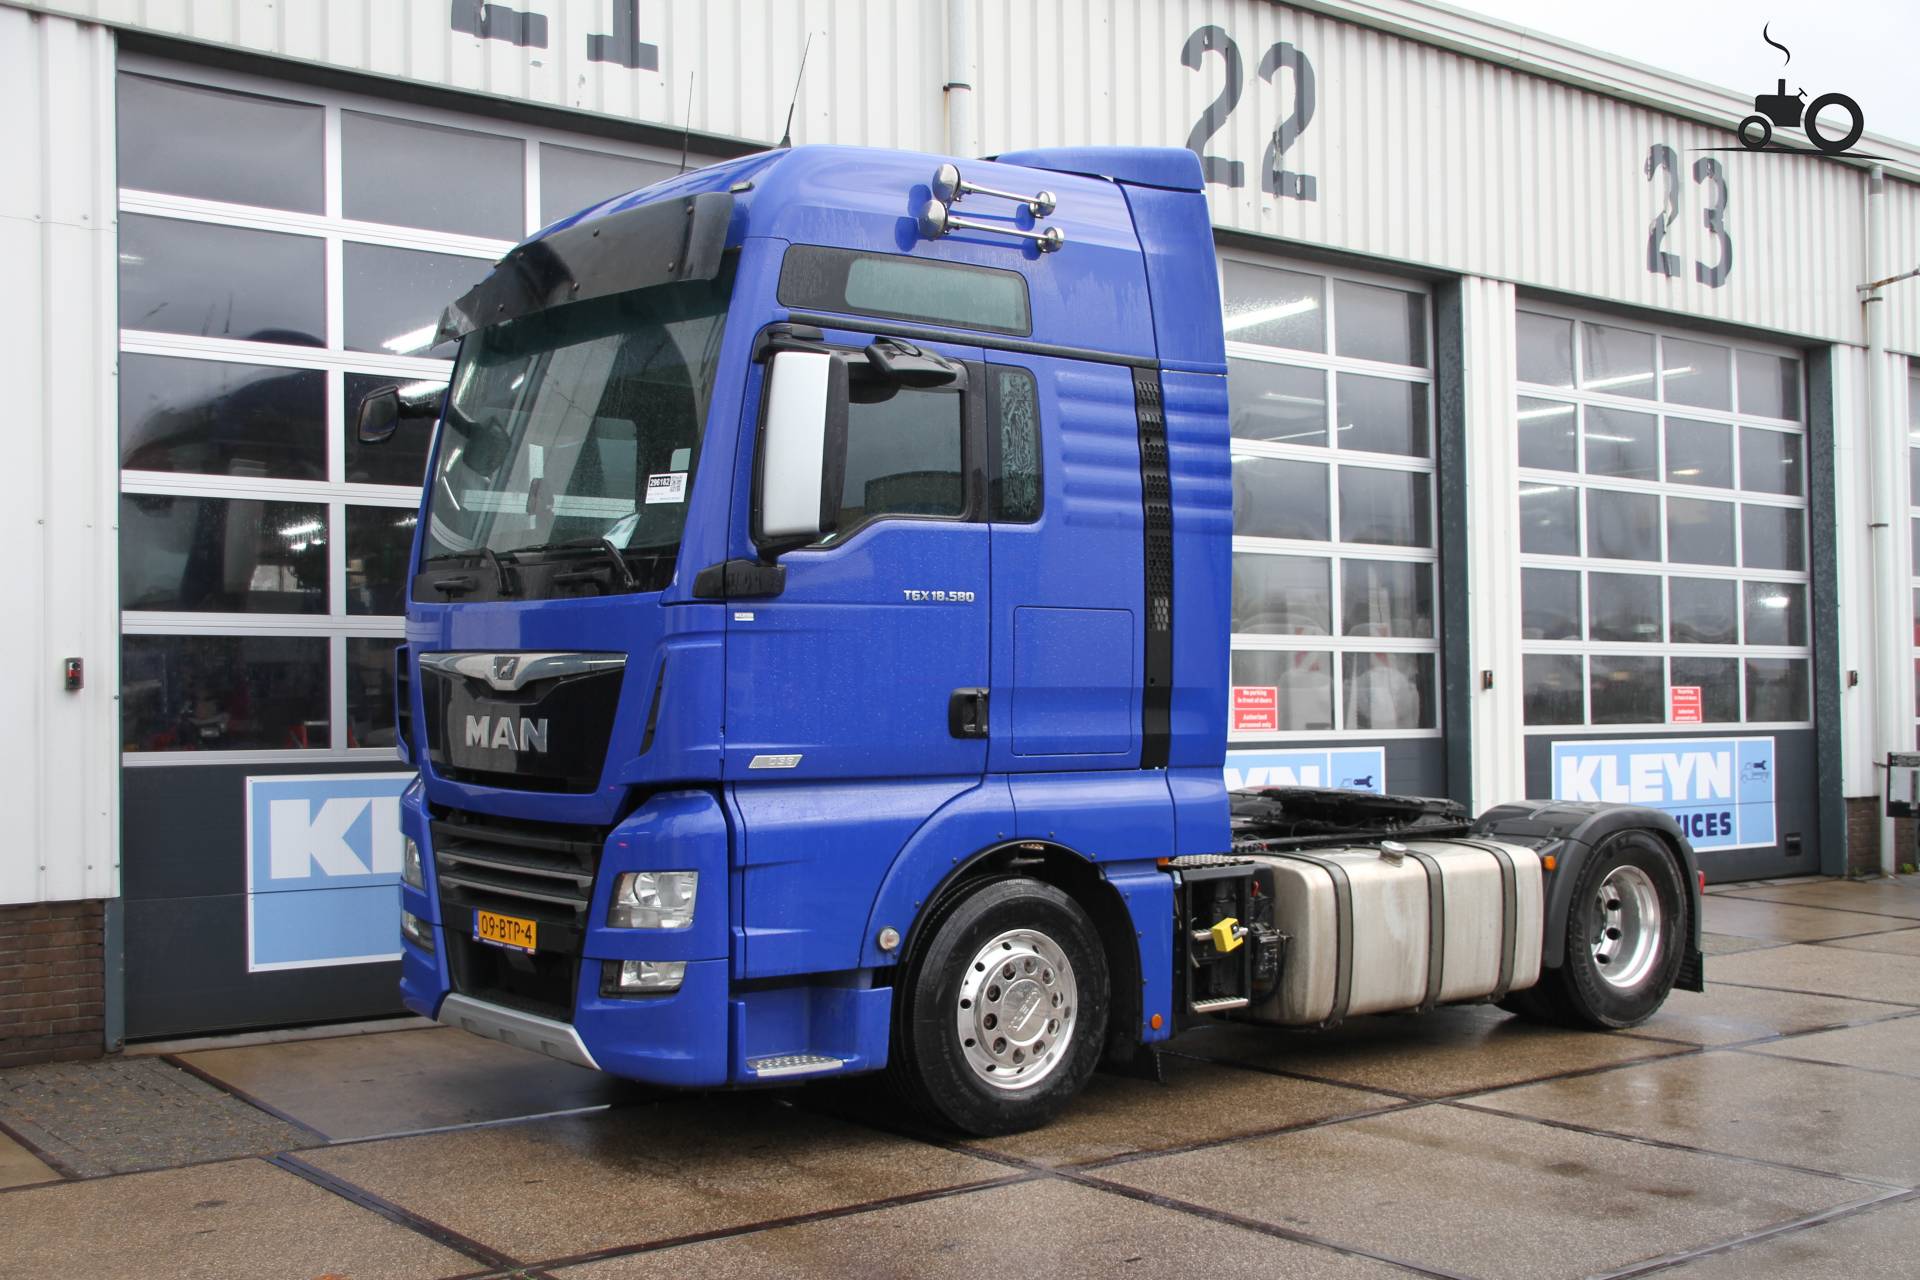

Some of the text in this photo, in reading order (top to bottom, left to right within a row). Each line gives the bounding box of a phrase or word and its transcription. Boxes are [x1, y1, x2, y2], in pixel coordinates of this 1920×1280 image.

[1181, 25, 1316, 202] 22
[1644, 144, 1732, 289] 23
[904, 590, 975, 602] TGX 18.580
[465, 714, 548, 753] MAN
[1561, 752, 1730, 803] KLEYN
[1677, 812, 1732, 838] ICES
[481, 914, 533, 945] 09-BTP-4
